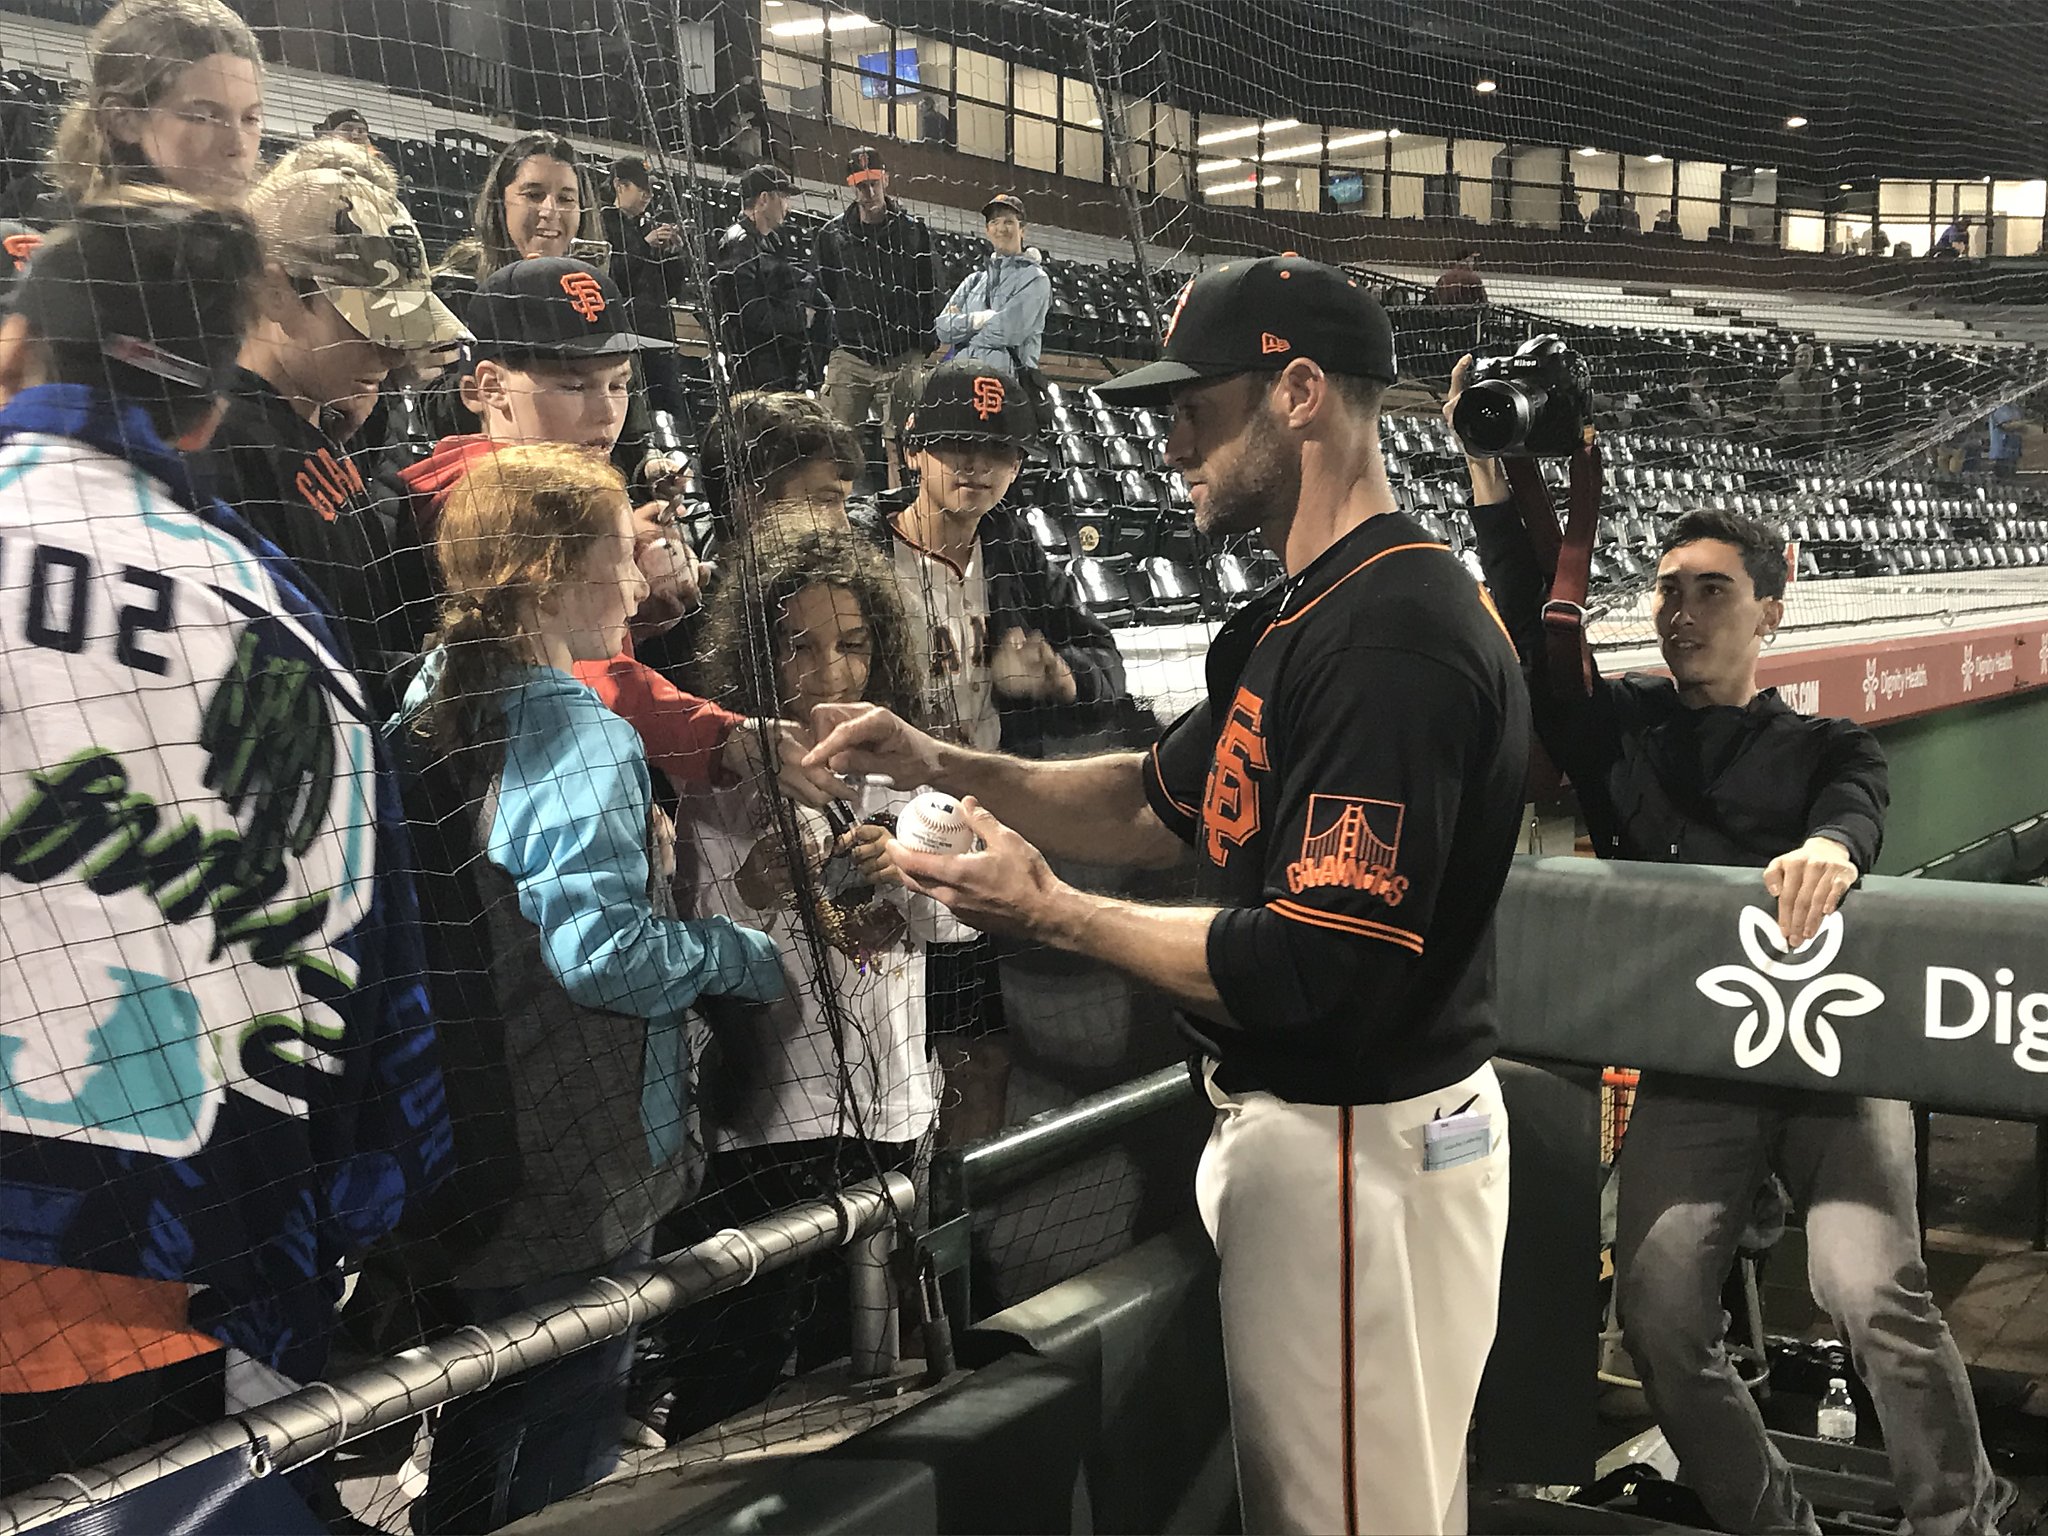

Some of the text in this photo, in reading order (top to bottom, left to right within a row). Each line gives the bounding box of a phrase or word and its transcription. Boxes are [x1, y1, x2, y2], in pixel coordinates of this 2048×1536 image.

[560, 271, 606, 322] SF
[1513, 359, 1537, 367] Nikon
[973, 376, 1005, 421] SF
[0, 535, 174, 677] 02
[1880, 663, 1928, 700] Dignity Health
[1975, 649, 2013, 683] Dignity Health
[1203, 686, 1271, 868] SF
[1286, 855, 1409, 906] GIANTS
[1925, 966, 2048, 1073] Dig
